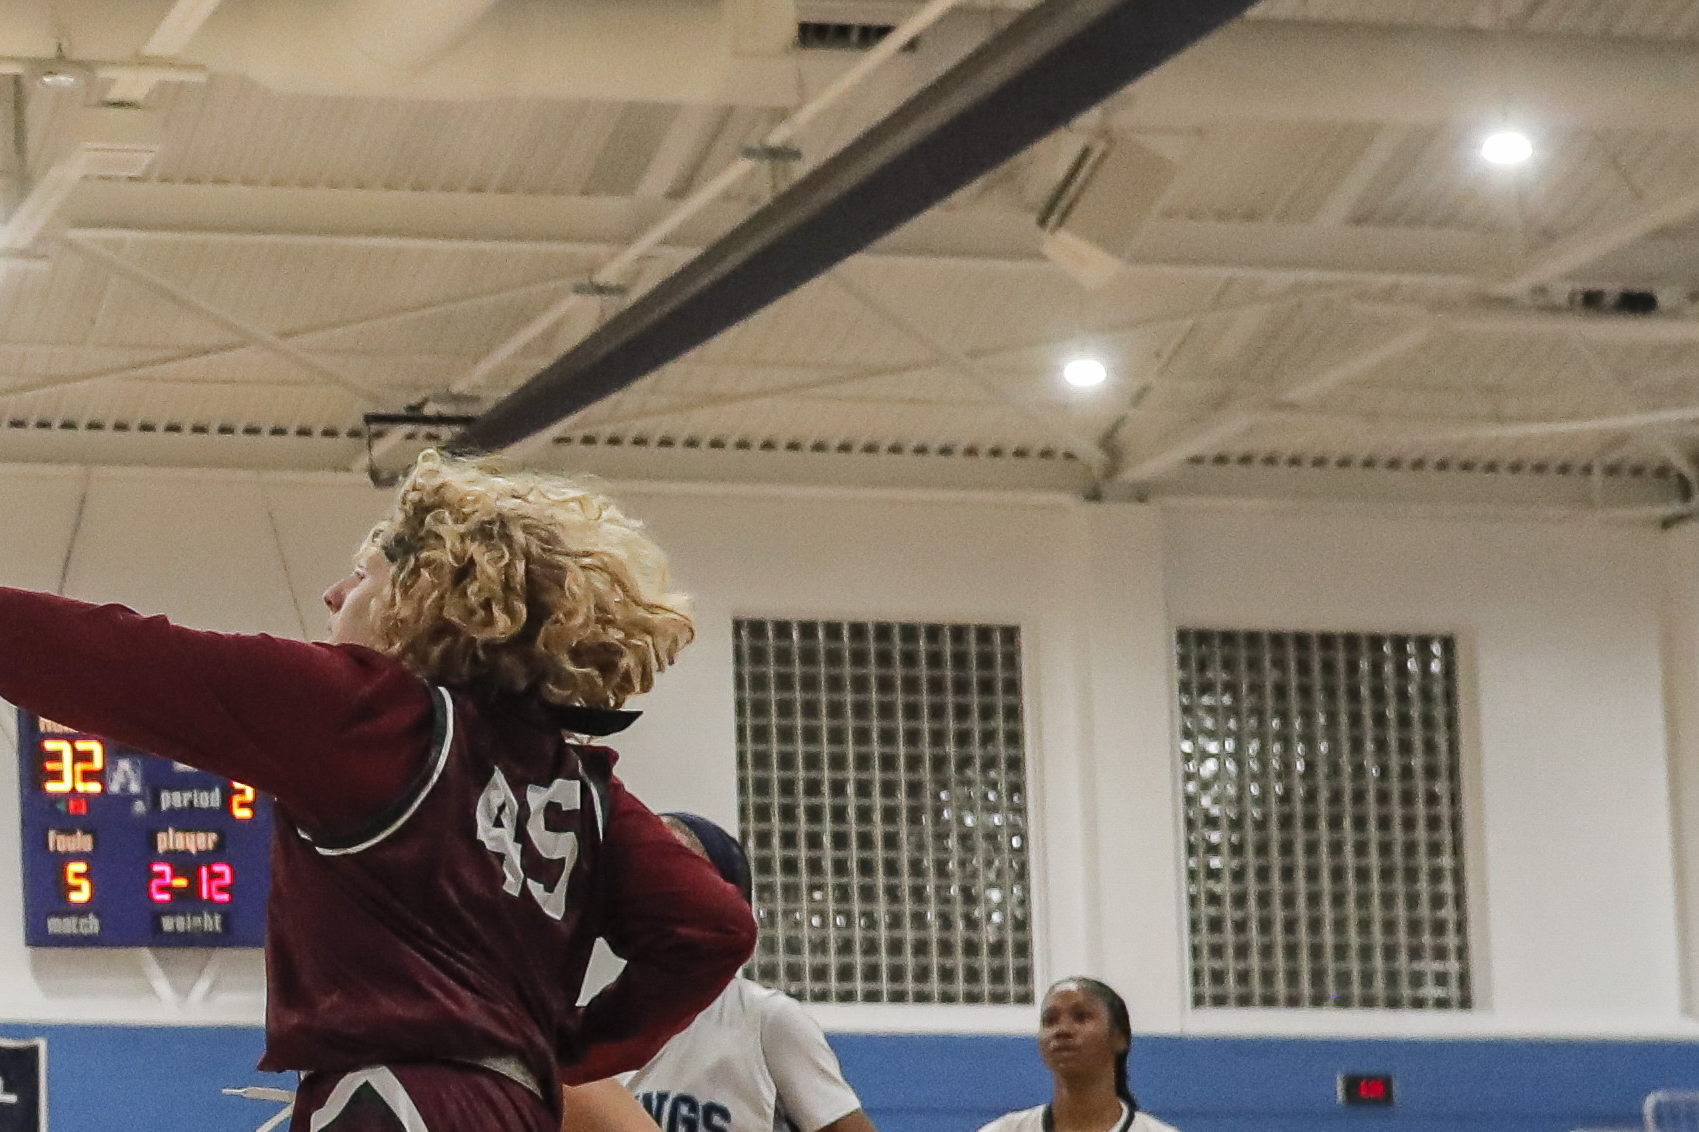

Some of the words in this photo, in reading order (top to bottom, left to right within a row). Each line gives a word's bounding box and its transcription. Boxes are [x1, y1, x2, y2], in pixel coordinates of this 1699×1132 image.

[42, 738, 105, 793] 32
[160, 786, 222, 811] period
[229, 780, 256, 820] 2
[156, 827, 219, 854] player
[64, 860, 93, 903] 5
[47, 913, 100, 936] match
